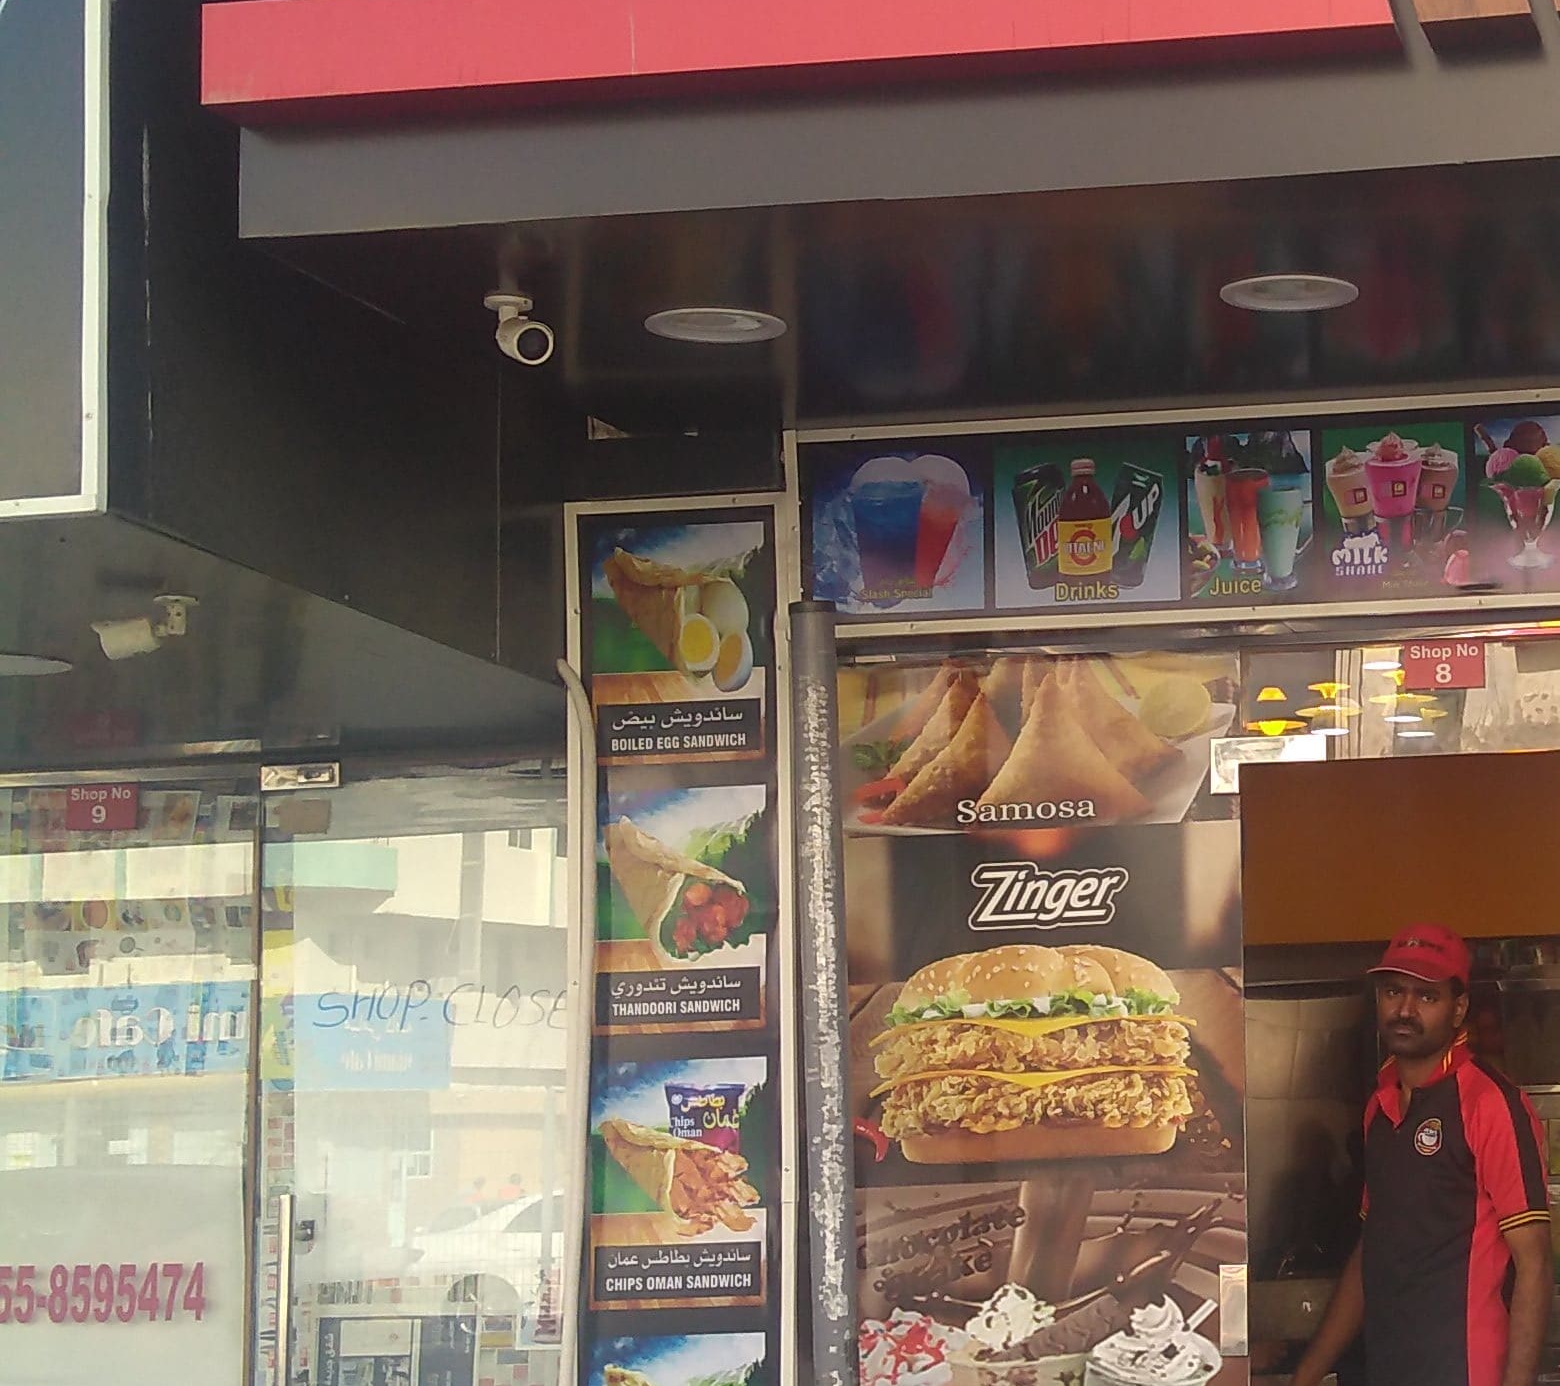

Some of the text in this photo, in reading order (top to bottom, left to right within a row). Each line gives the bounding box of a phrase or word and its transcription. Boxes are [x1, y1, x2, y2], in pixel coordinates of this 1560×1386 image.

[1331, 546, 1388, 566] MILK
[1055, 581, 1119, 601] Drinks
[1209, 577, 1262, 596] Juice
[1410, 642, 1479, 660] Shop No
[1434, 664, 1452, 684] 8
[611, 709, 656, 732] بيض
[611, 731, 747, 752] BOILED EGG SANDWICH
[70, 786, 132, 804] Shop No
[90, 805, 107, 824] 9
[957, 798, 1096, 824] Samosa
[976, 869, 1118, 923] Zinger
[612, 995, 741, 1017] THANDOORI SANDWICH
[607, 1251, 639, 1269] عمان
[606, 1273, 752, 1292] CHIPS OMAN SANDWICH
